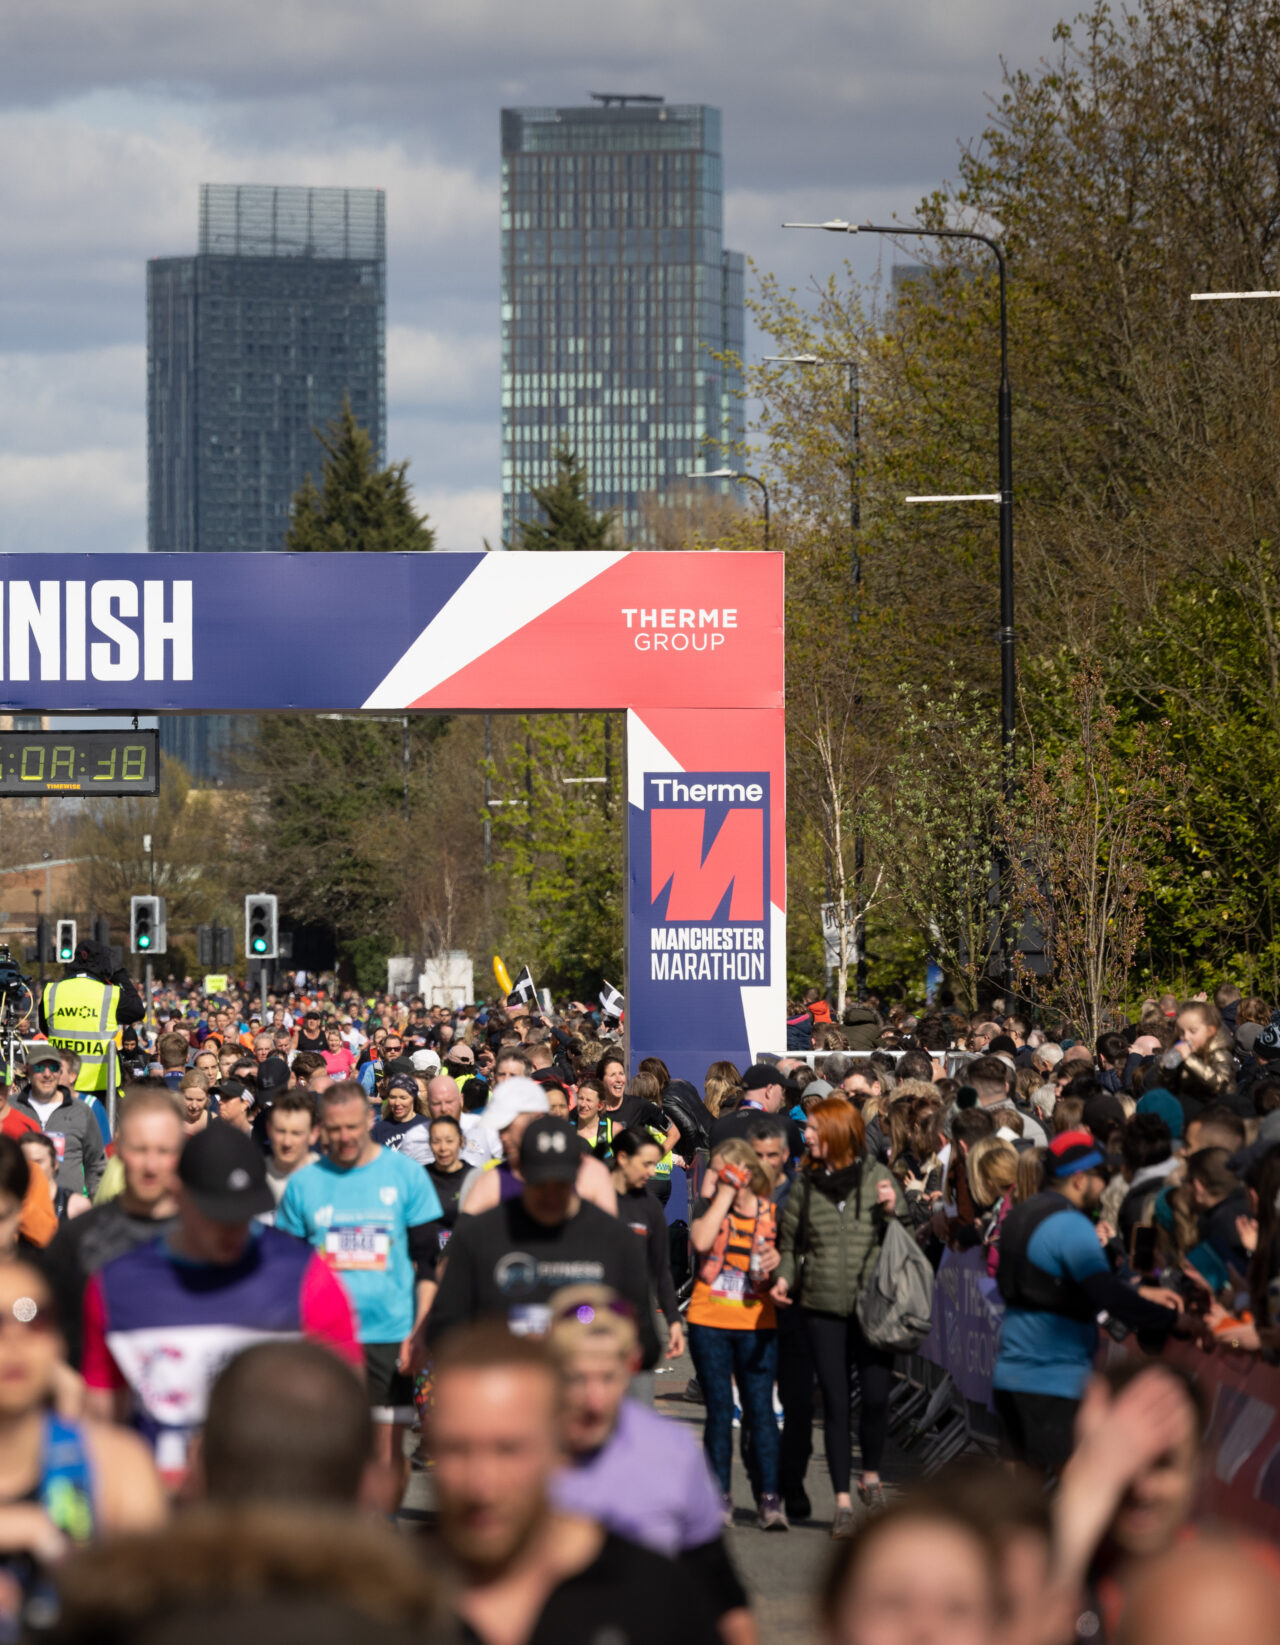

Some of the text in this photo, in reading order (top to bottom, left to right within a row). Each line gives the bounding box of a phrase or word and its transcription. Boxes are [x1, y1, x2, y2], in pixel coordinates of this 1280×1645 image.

[621, 608, 738, 628] THERME
[634, 632, 725, 651] GROUP
[650, 779, 763, 802] Therme
[651, 927, 764, 950] MANCHESTER
[651, 952, 765, 981] MARATHON
[52, 1039, 104, 1055] MEDIA
